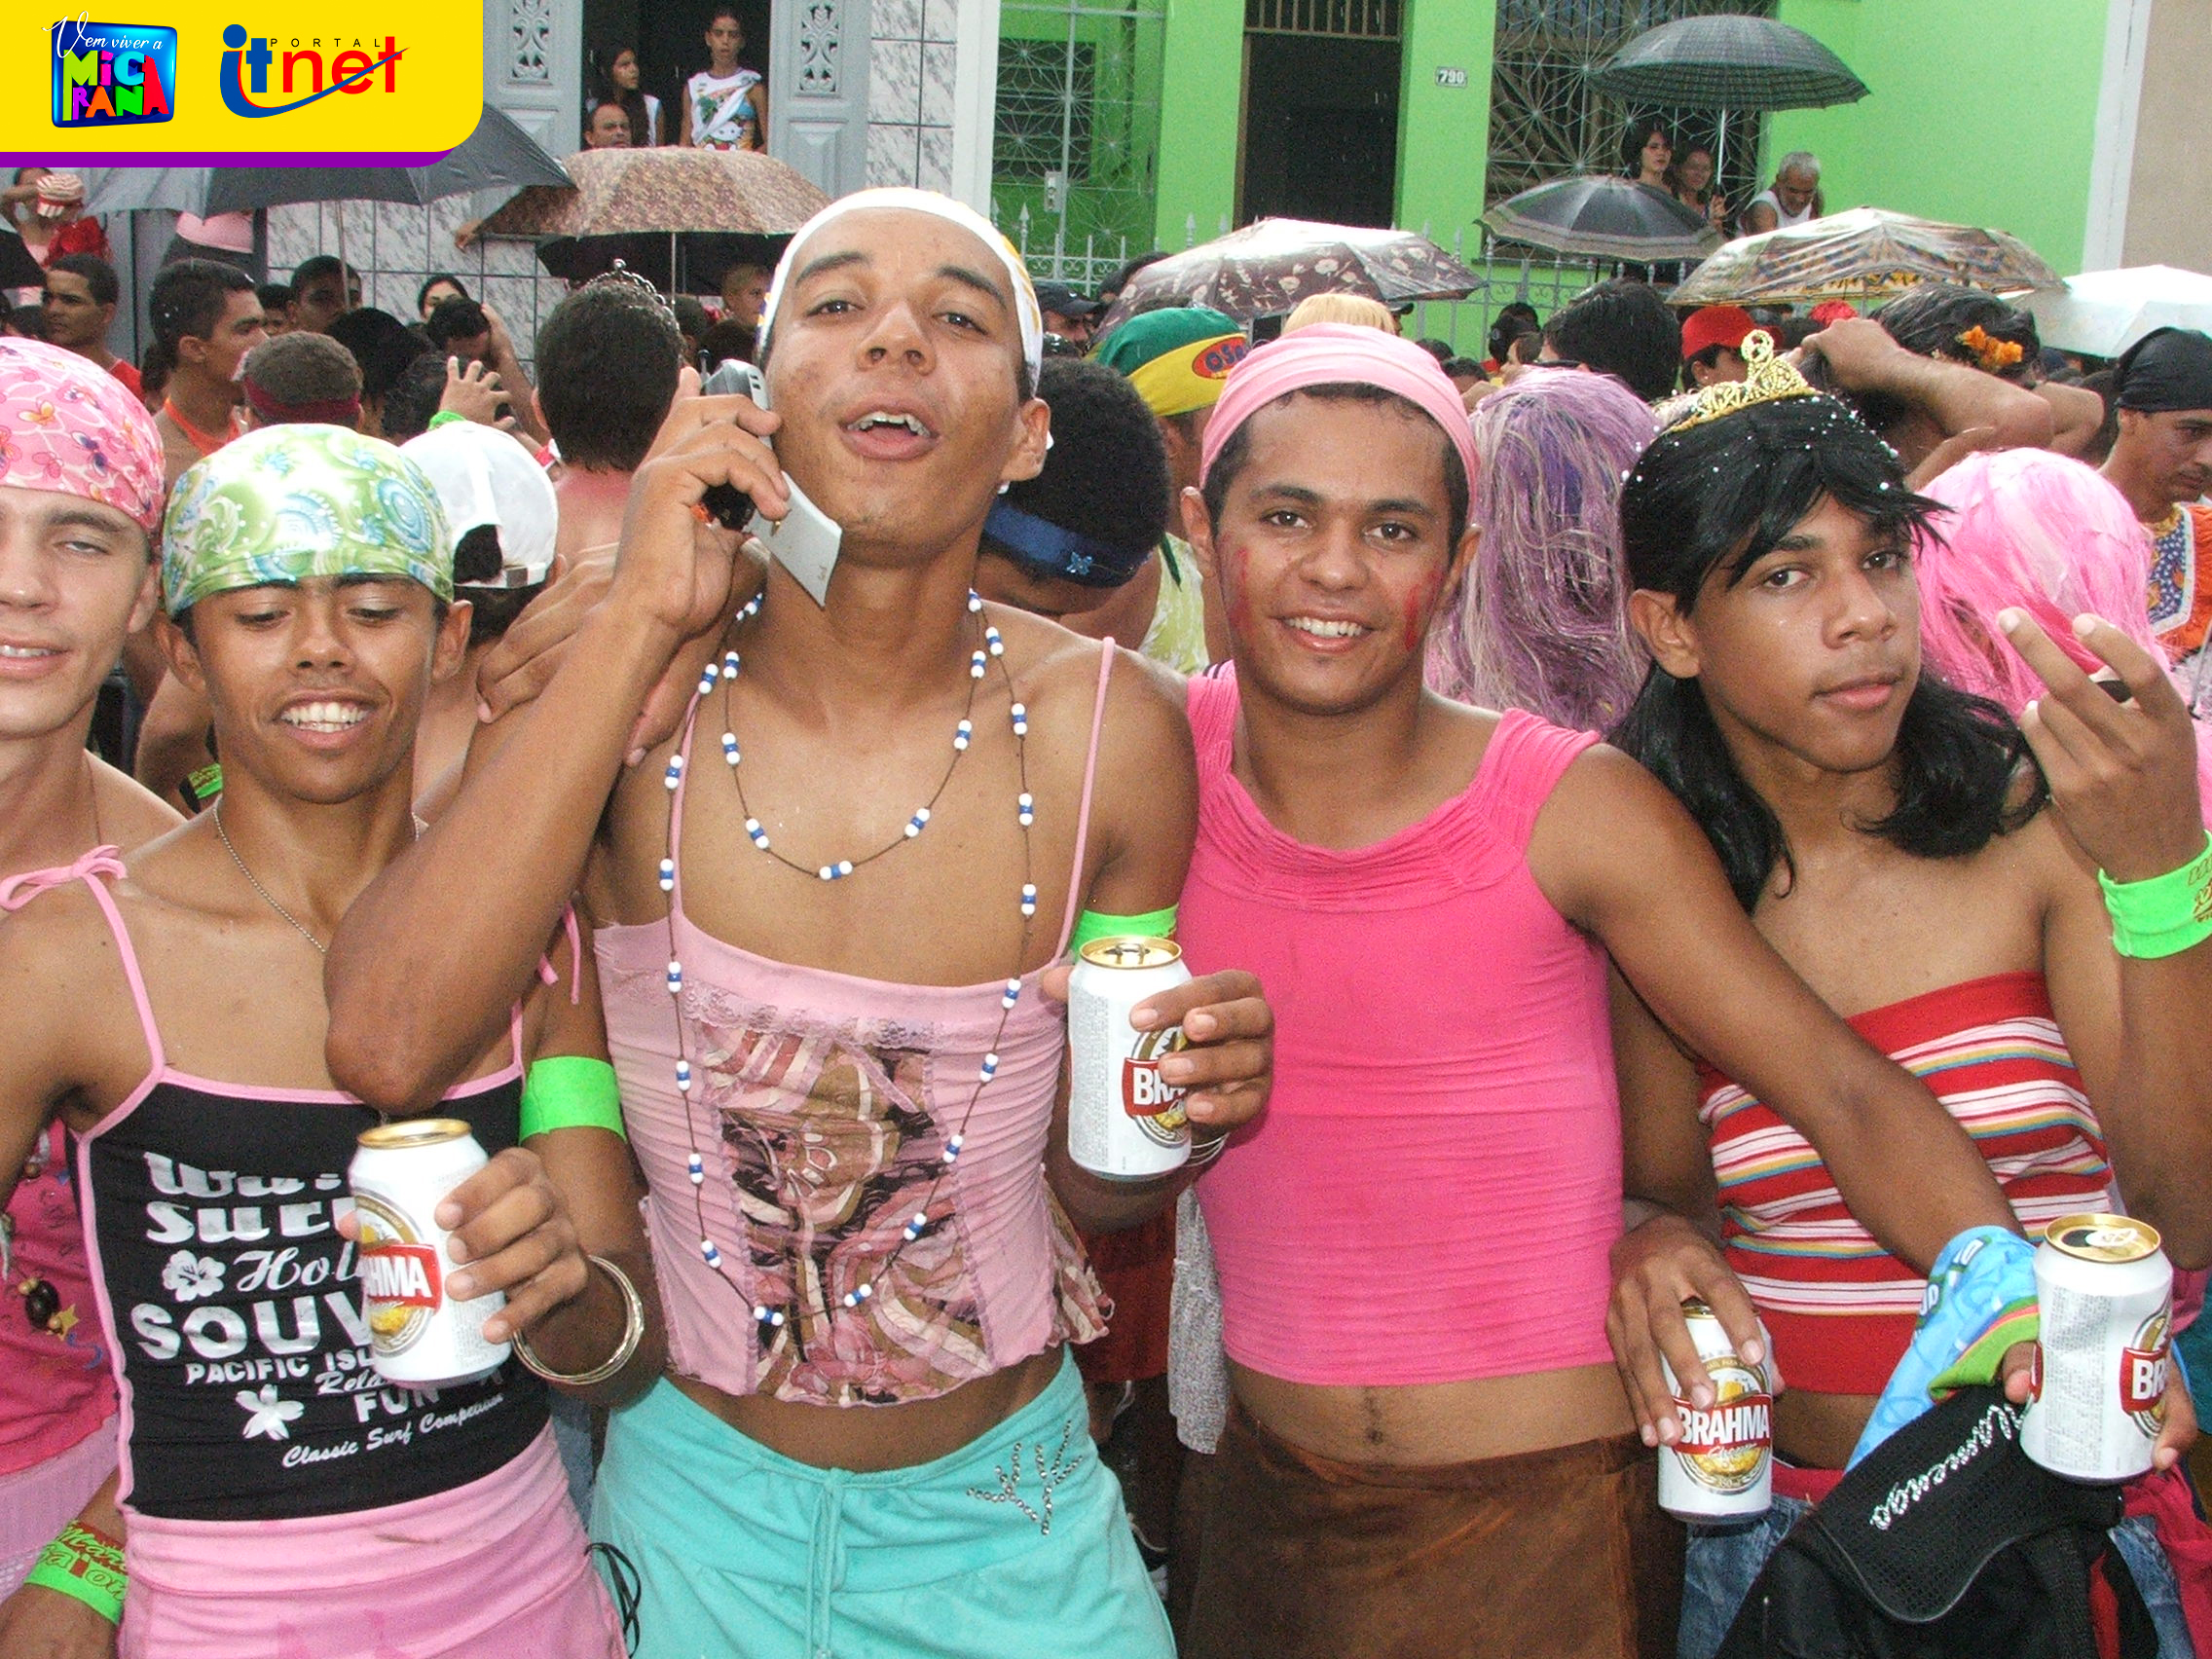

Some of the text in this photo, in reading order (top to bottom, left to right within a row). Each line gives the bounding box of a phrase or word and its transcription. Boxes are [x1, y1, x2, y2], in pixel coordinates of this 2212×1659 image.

[1439, 69, 1465, 85] 790
[185, 1356, 311, 1385] PACIFIC
[1678, 1404, 1771, 1446] BRAHMA
[281, 1441, 359, 1469] Classic
[365, 1420, 413, 1452] Surf
